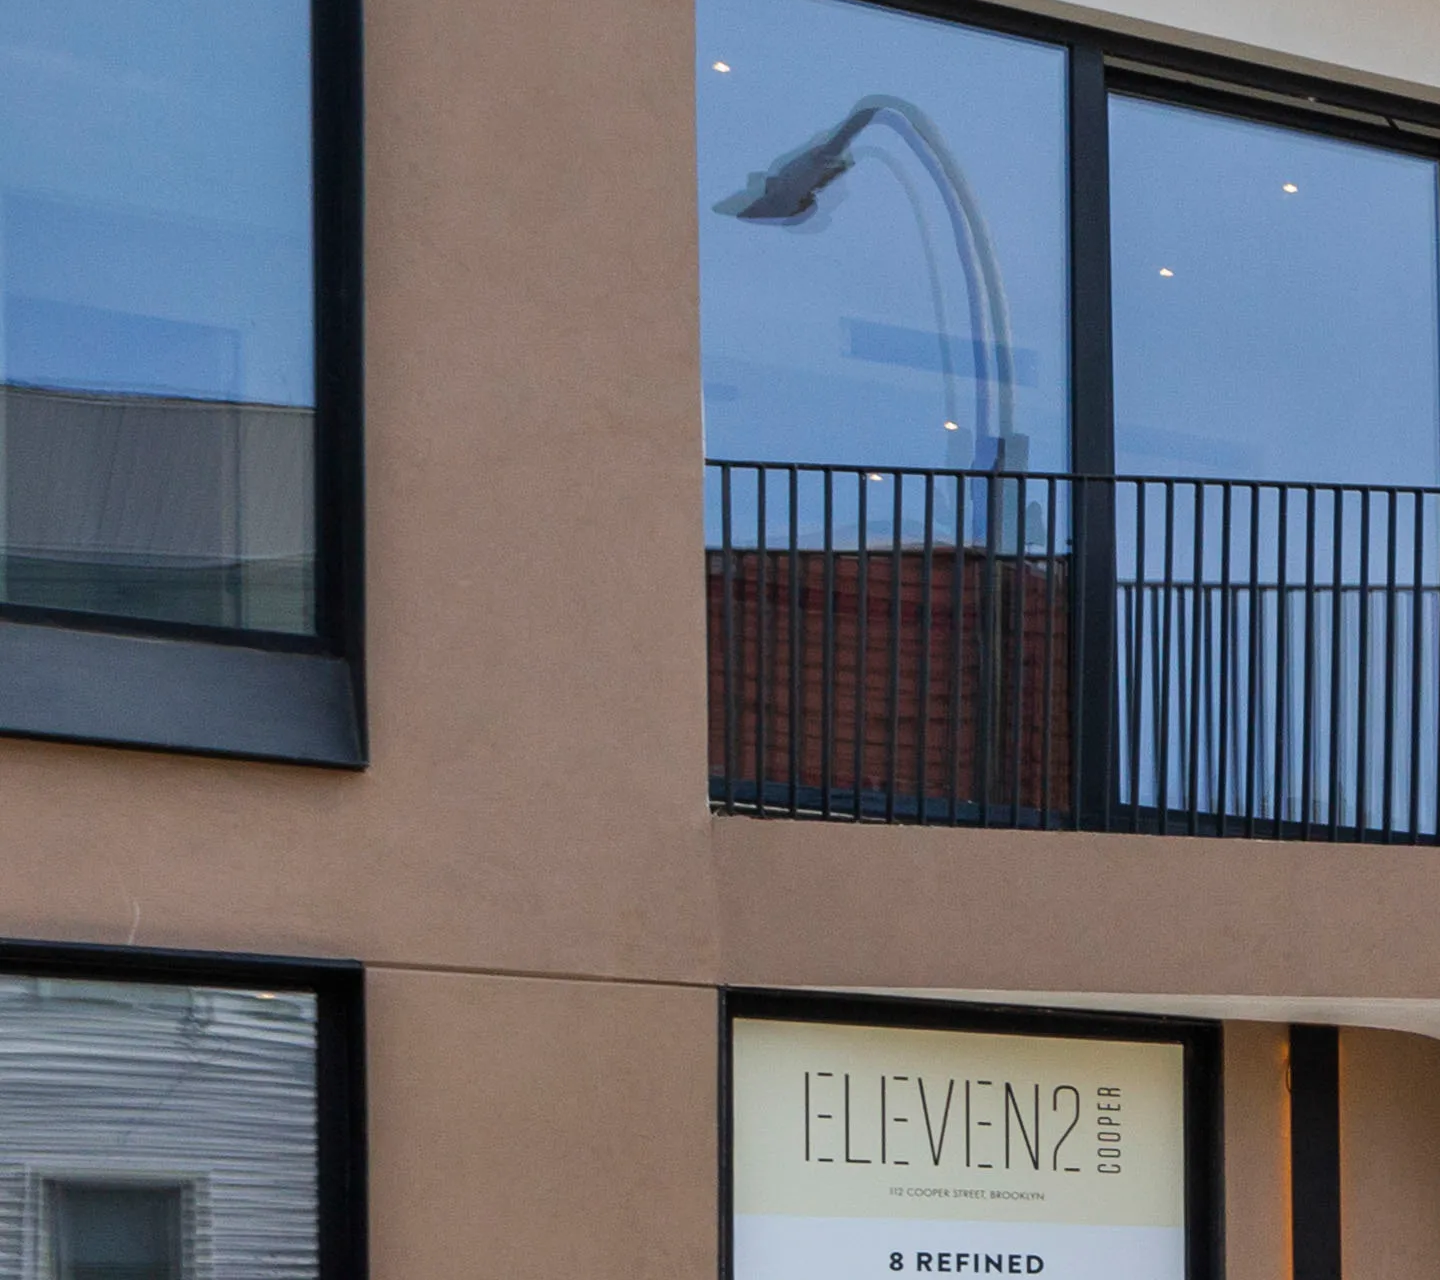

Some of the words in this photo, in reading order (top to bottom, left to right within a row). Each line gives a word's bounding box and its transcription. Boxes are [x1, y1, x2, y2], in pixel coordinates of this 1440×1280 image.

[805, 1072, 1080, 1172] ELEVEN2
[1097, 1087, 1121, 1173] COOPER
[889, 1187, 904, 1197] 112
[907, 1188, 950, 1197] COOPER
[990, 1190, 1045, 1201] BROOKLYN
[890, 1252, 903, 1271] 8
[917, 1252, 1044, 1274] REFINED
